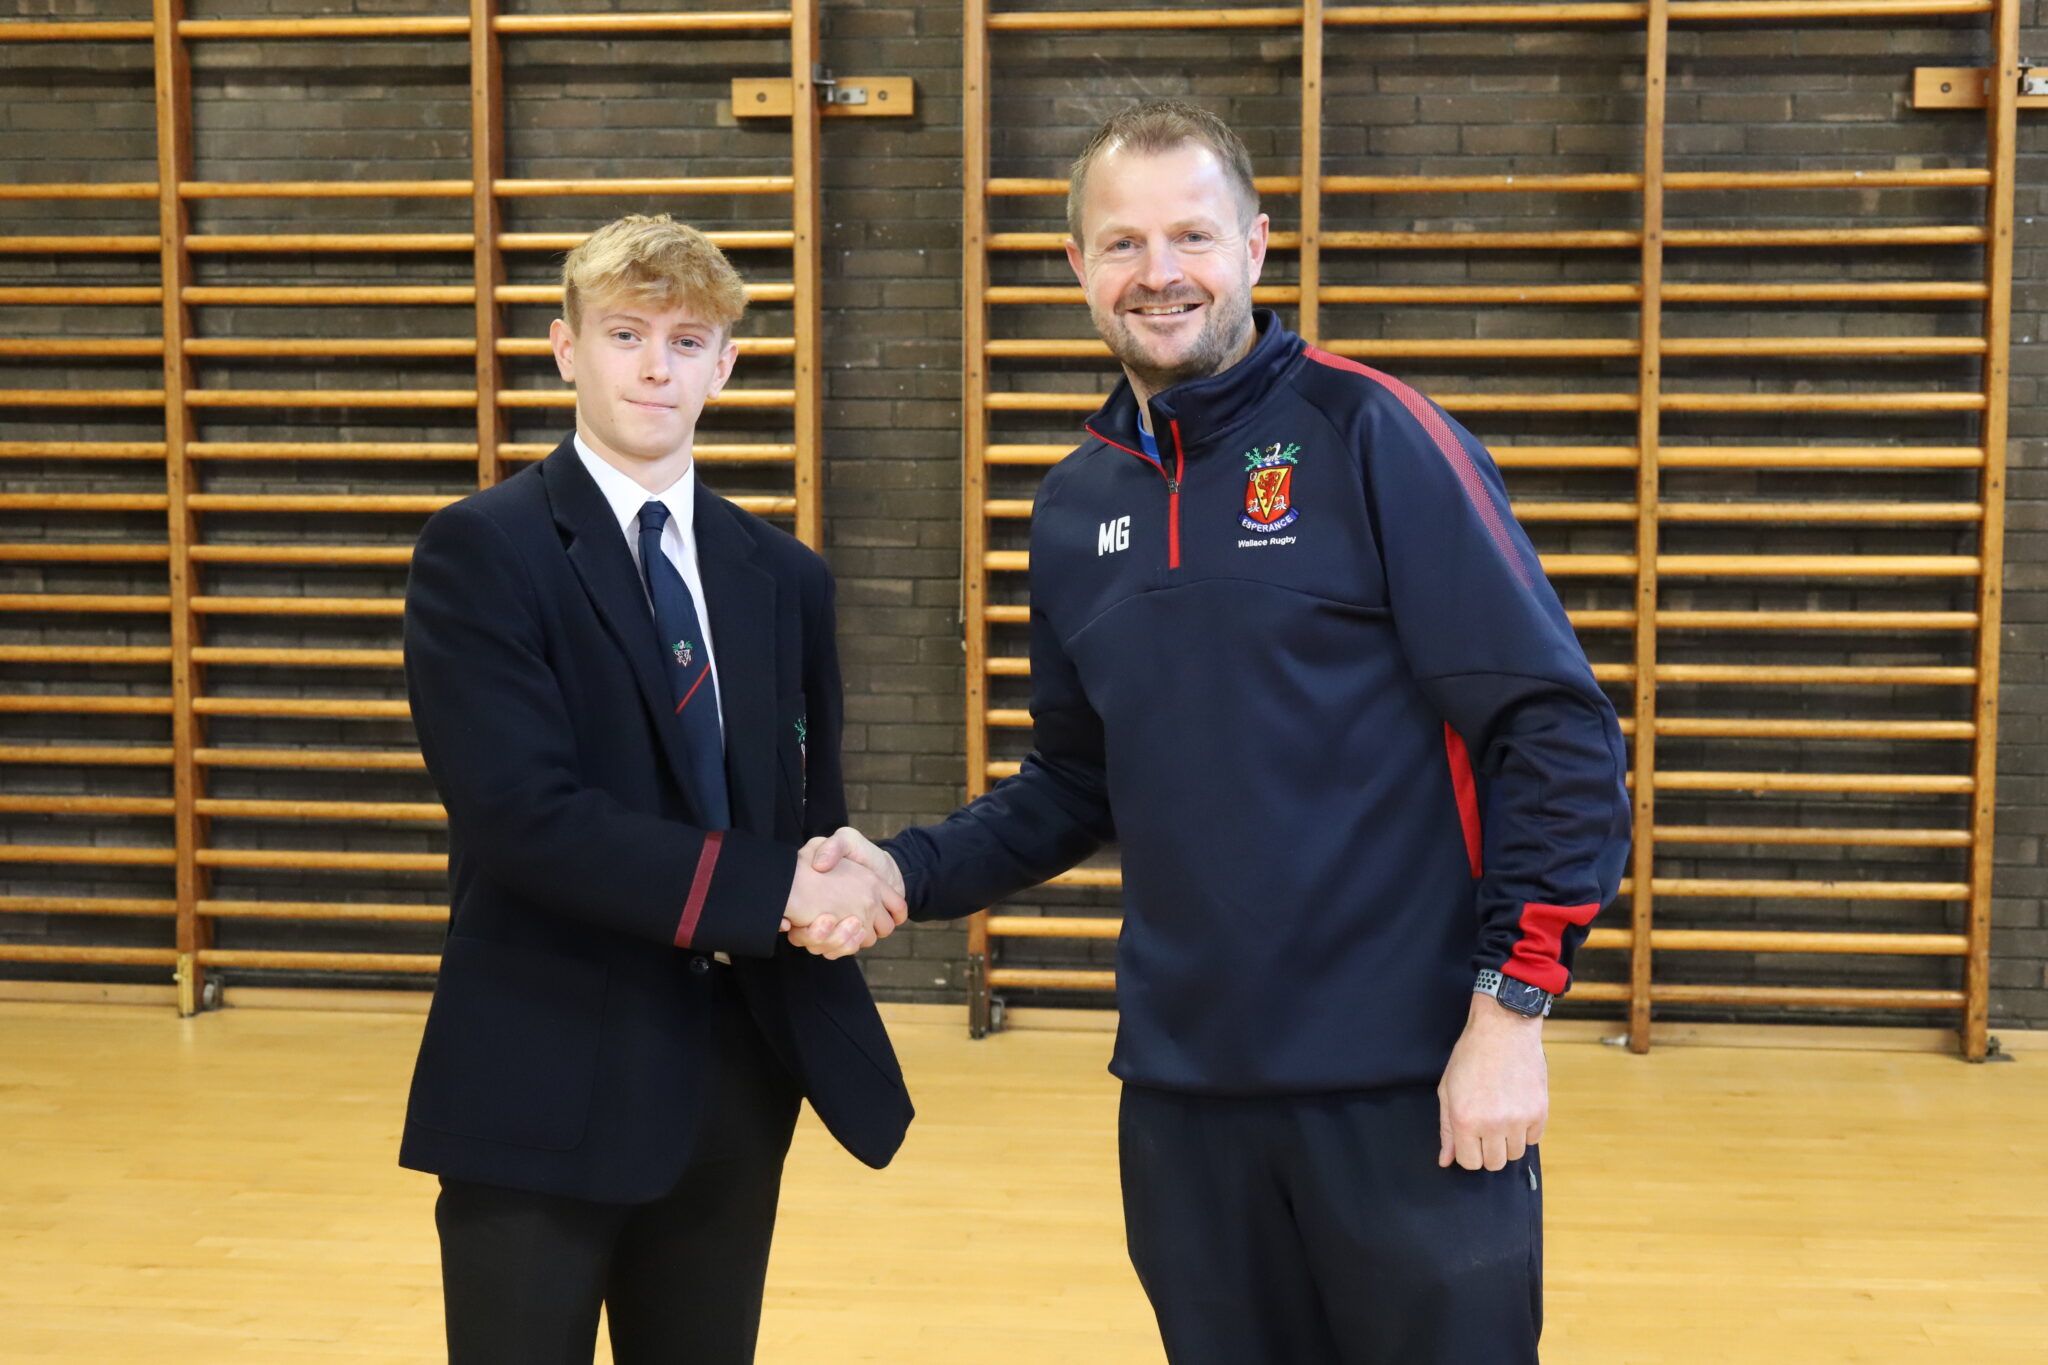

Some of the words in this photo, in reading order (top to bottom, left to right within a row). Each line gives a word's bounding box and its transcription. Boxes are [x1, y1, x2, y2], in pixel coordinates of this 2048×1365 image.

[1241, 515, 1294, 533] ESPERANCE
[1098, 515, 1130, 556] MG
[1238, 538, 1268, 549] Wallace
[1270, 536, 1297, 546] Rugby
